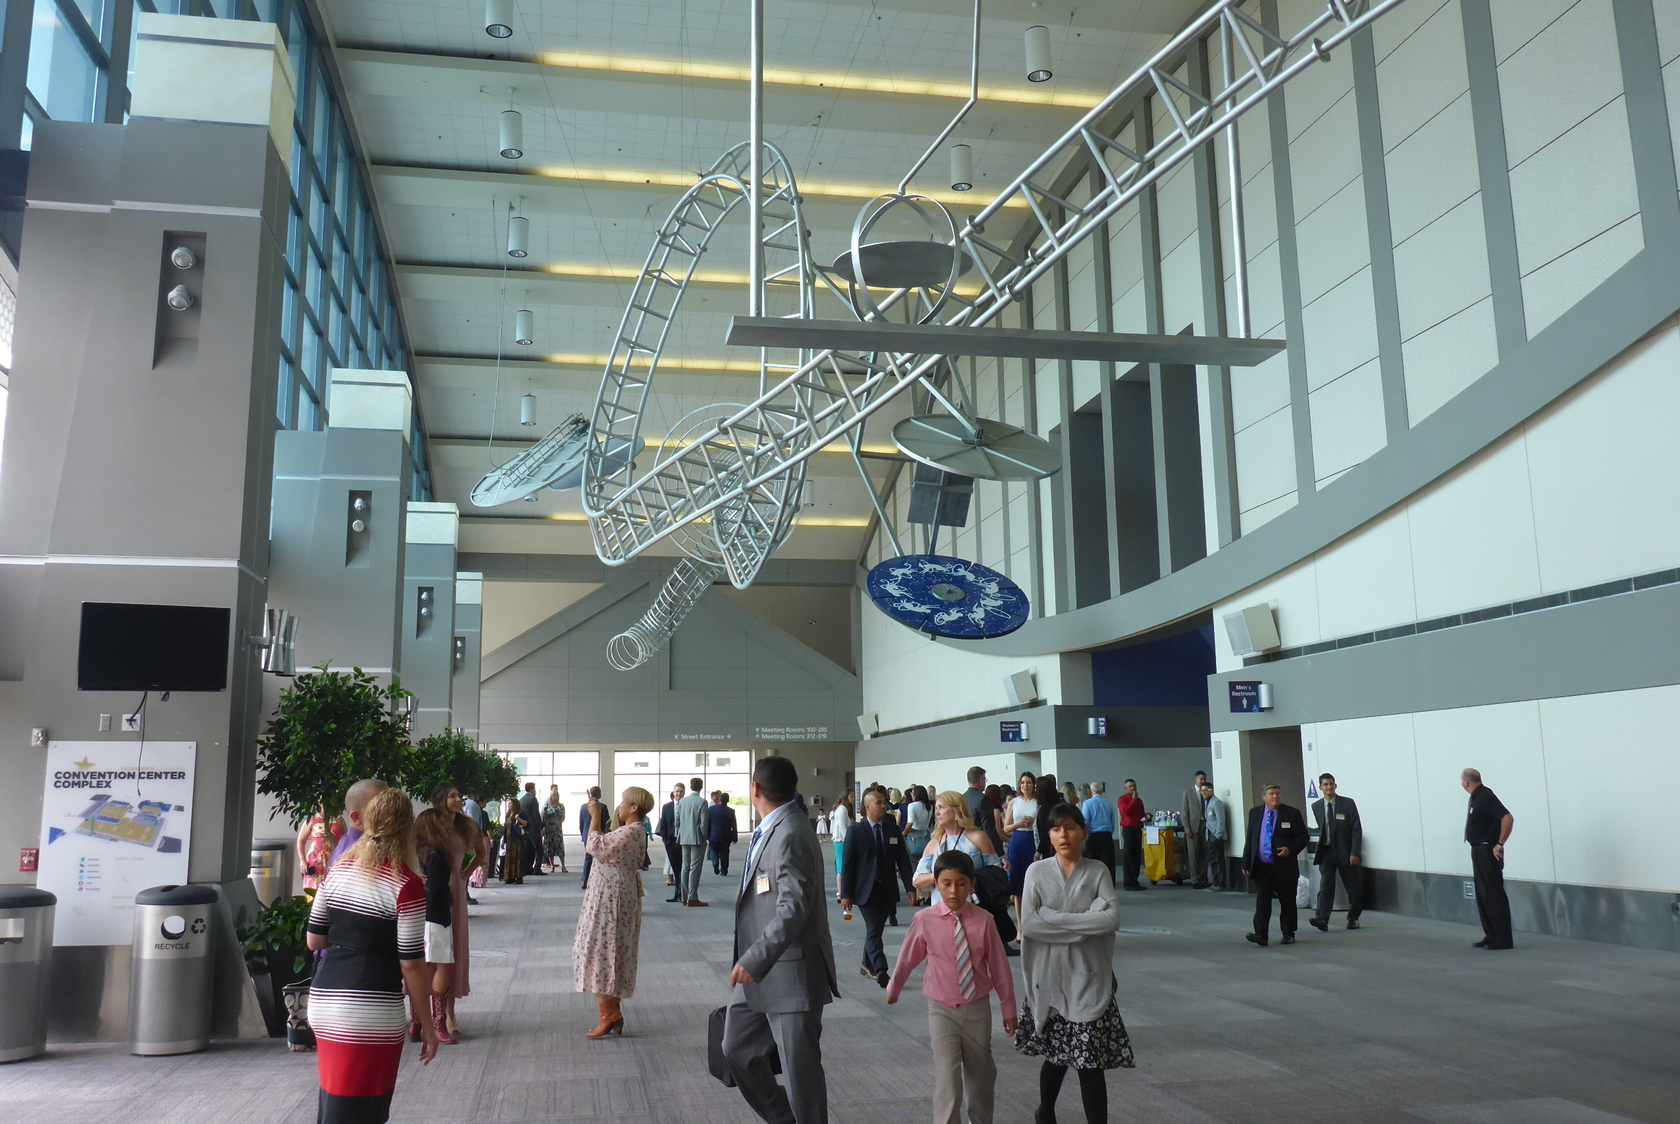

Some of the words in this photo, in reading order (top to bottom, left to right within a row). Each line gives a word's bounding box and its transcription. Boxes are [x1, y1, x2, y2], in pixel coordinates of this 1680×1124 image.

[761, 726, 785, 734] Meeting
[761, 733, 785, 741] Meeting
[54, 771, 136, 780] CONVENTION
[138, 771, 186, 780] CENTER
[53, 780, 112, 789] COMPLEX
[154, 942, 191, 950] RECYCLE
